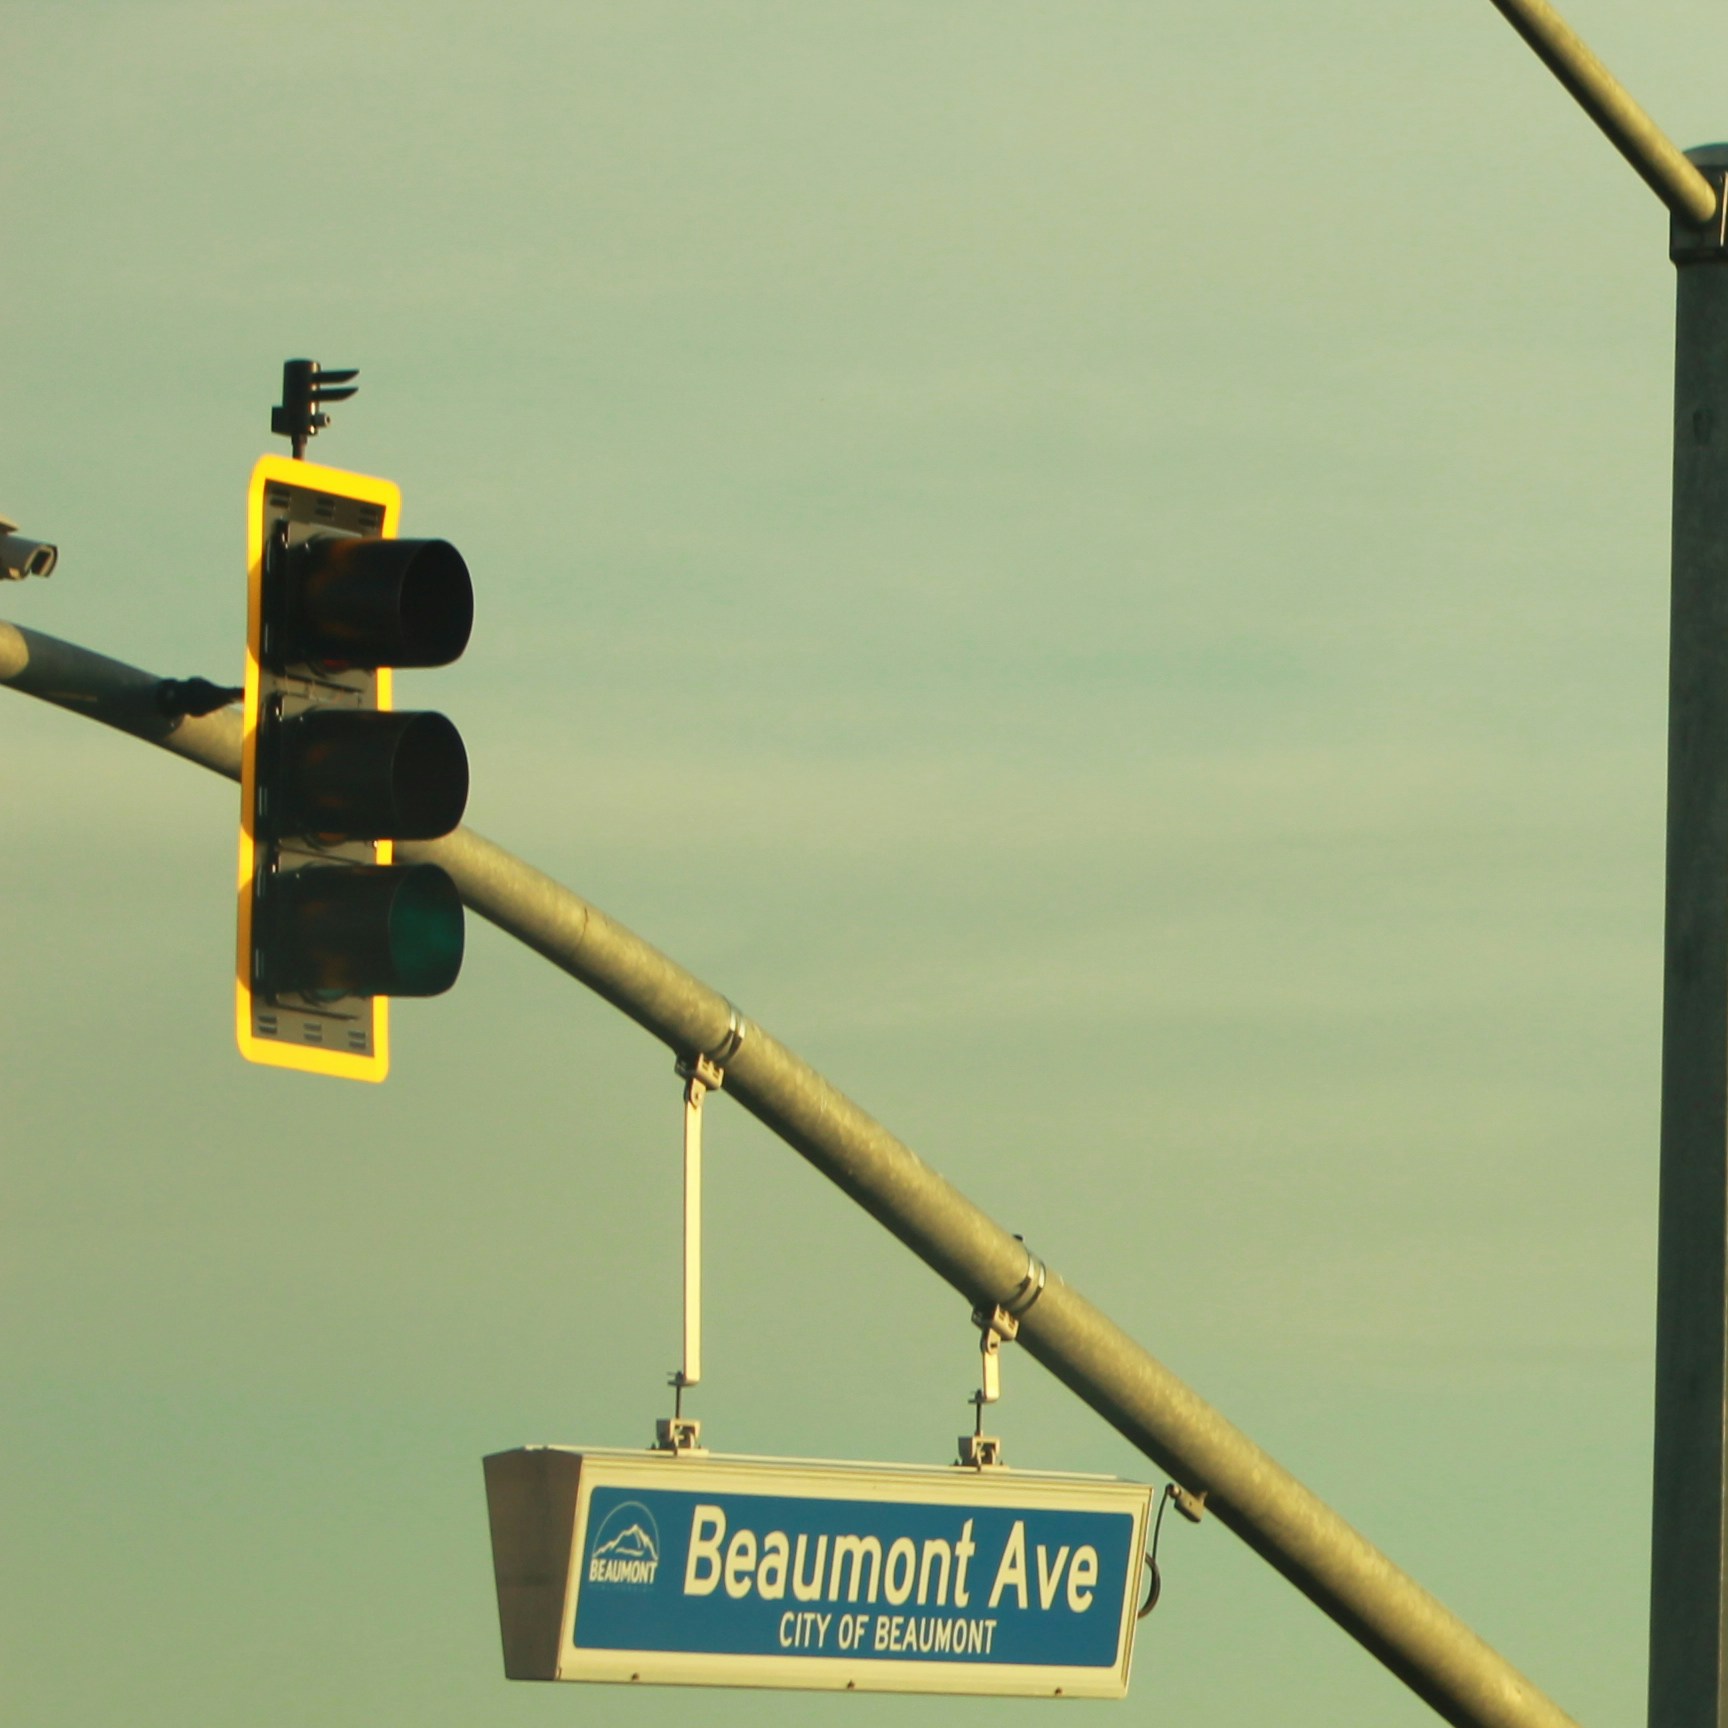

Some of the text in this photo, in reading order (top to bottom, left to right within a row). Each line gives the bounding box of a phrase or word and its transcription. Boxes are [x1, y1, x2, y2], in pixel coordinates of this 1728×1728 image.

[589, 1558, 658, 1584] BEAUMONT
[683, 1504, 1098, 1613] Beaumont Ave
[779, 1611, 997, 1654] CITY OF BEAUMONT
